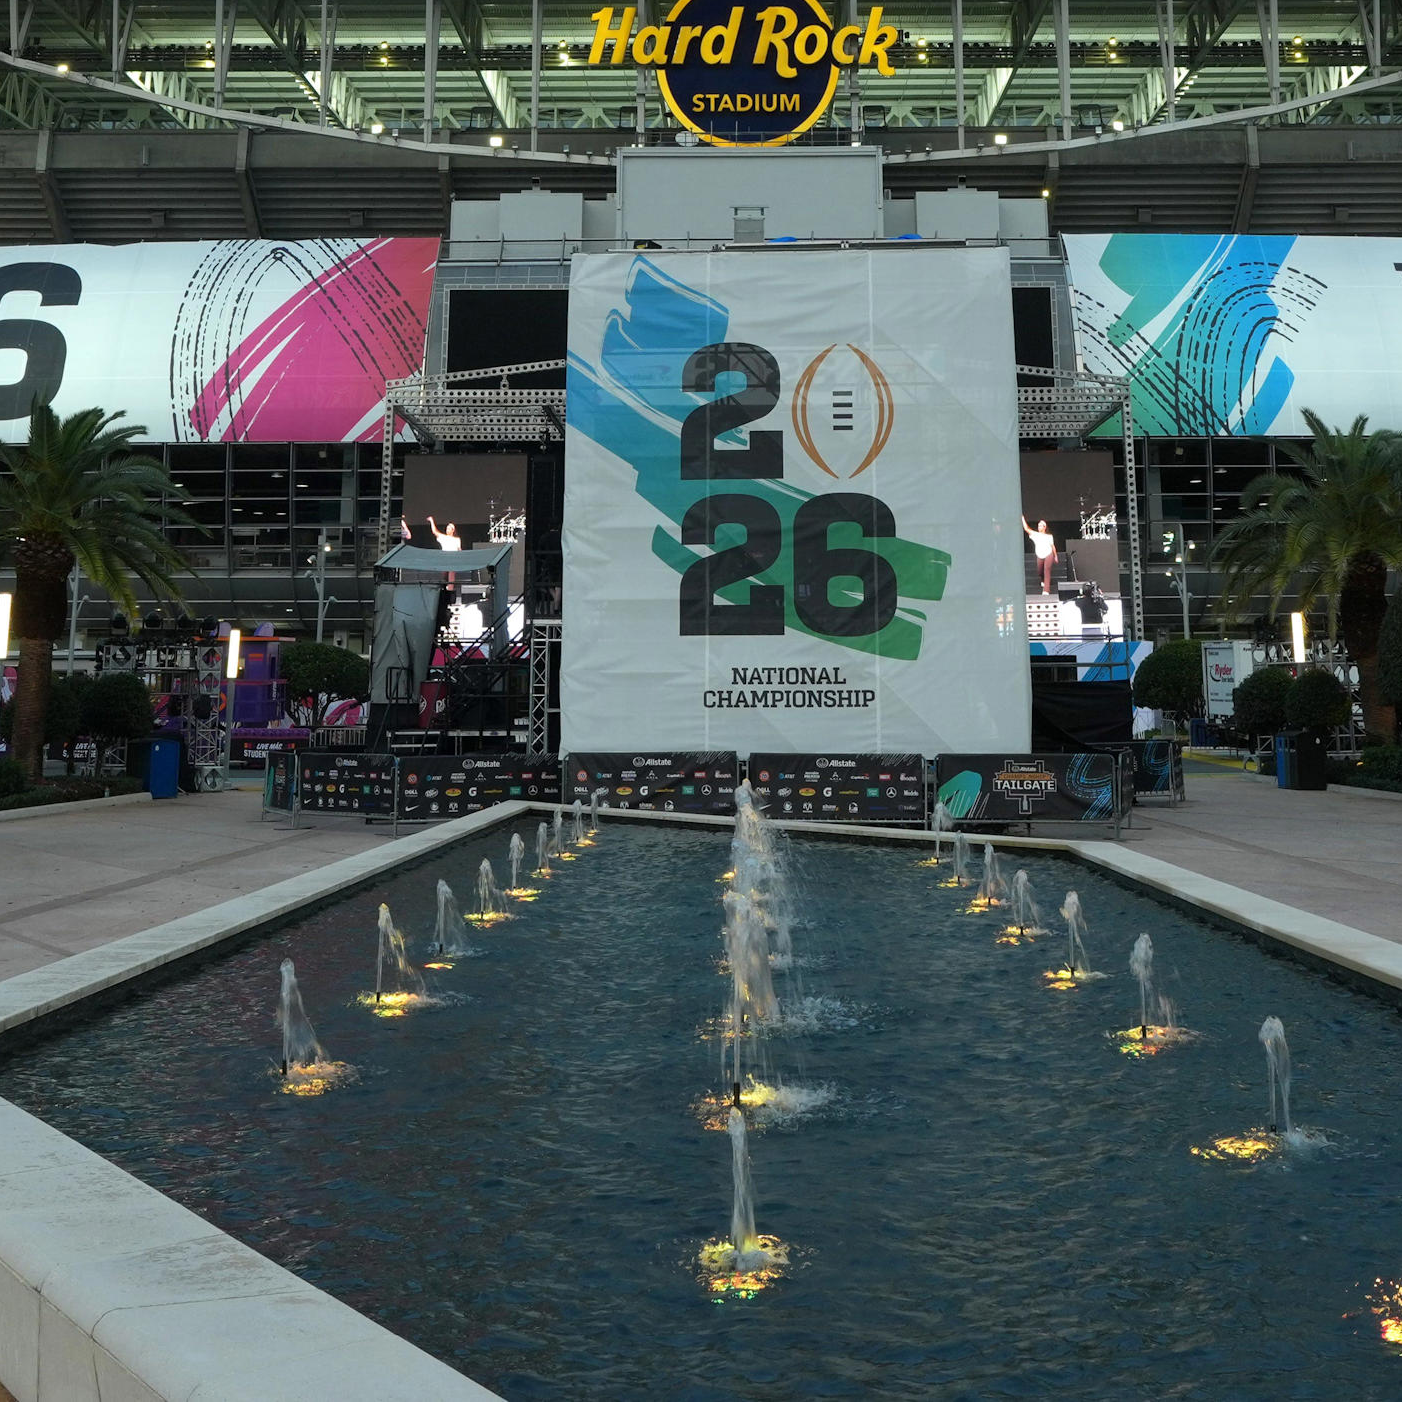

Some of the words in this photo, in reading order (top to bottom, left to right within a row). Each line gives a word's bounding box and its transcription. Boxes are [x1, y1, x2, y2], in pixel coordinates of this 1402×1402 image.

[587, 6, 745, 65] Hard
[752, 6, 898, 79] Rock
[691, 93, 801, 113] STADIUM
[679, 492, 898, 637] 26
[731, 667, 847, 685] NATIONAL
[702, 689, 876, 709] CHAMPIONSHIP
[474, 760, 501, 768] Allstate
[645, 758, 672, 766] Allstate
[828, 759, 857, 767] Allstate
[995, 780, 1055, 790] TAILGATE
